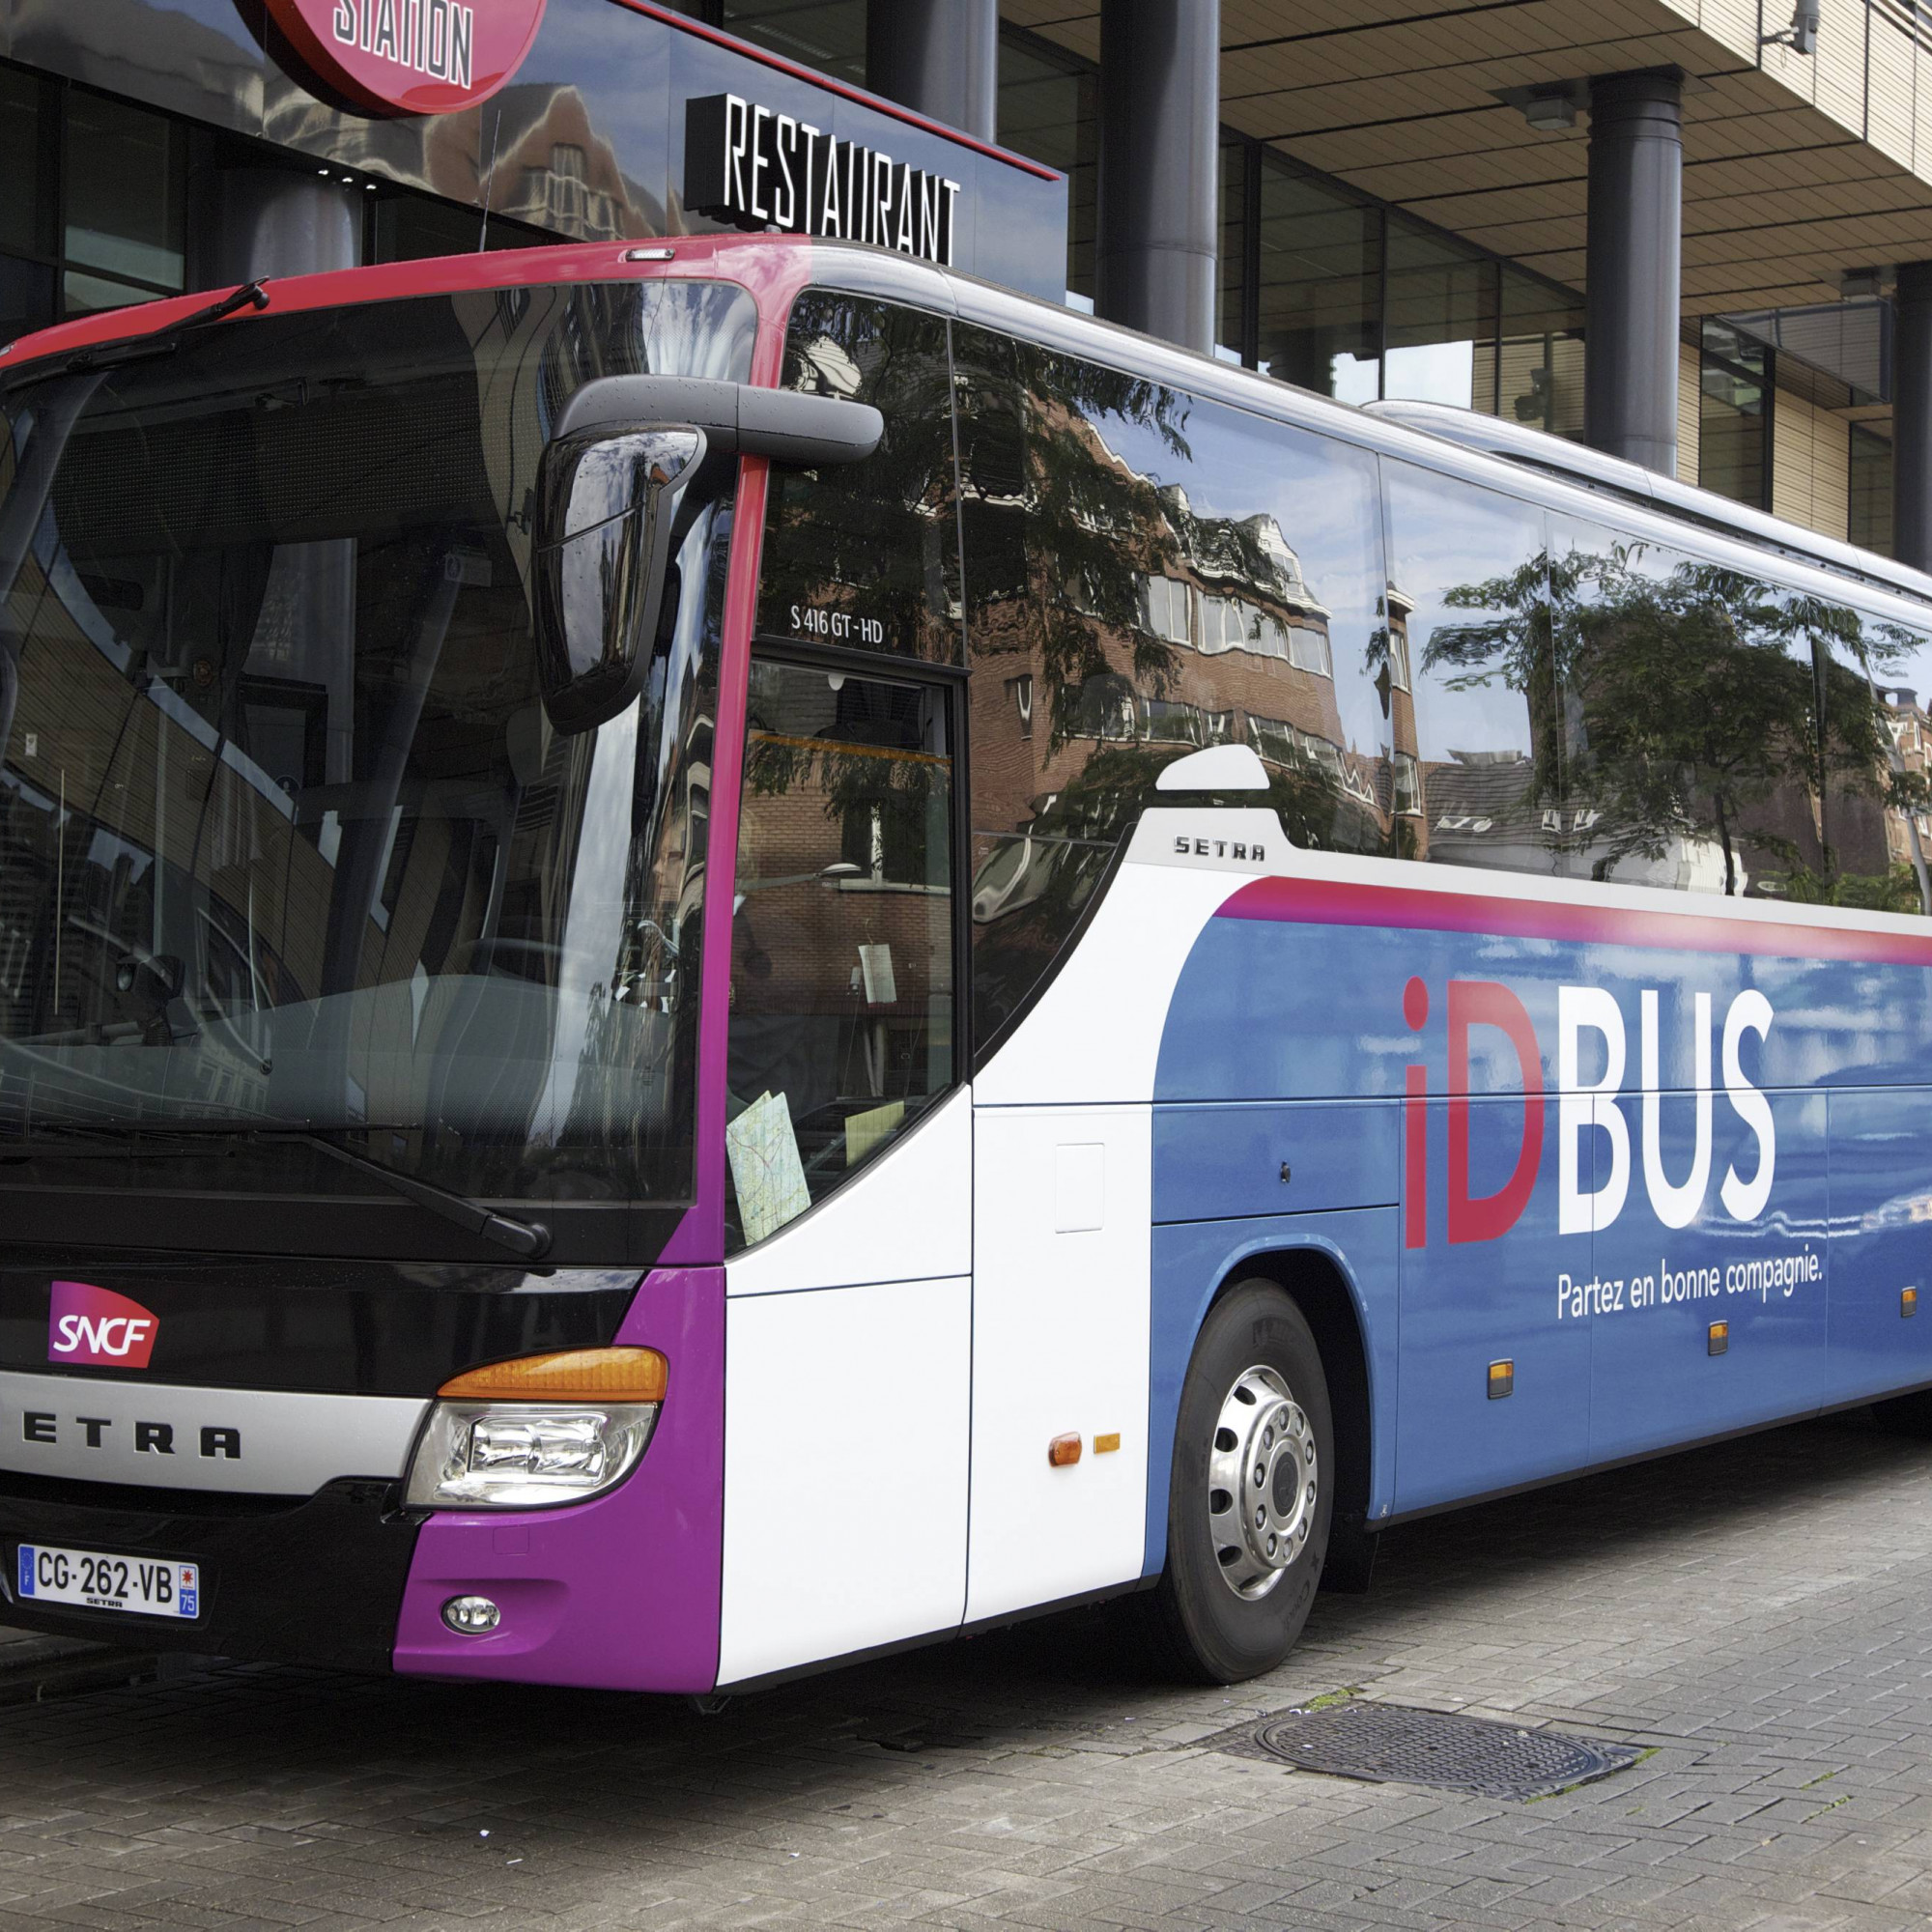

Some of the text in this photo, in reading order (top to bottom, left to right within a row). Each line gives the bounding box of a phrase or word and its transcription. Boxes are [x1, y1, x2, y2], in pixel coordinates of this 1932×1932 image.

[333, 0, 473, 90] STATION
[724, 93, 961, 268] RESTAURANT
[790, 605, 801, 630] S
[804, 608, 829, 635] 416
[1174, 835, 1265, 862] SETRA
[1557, 1243, 1823, 1320] Partez en bonne compagnie.
[52, 1315, 152, 1356] SNCF
[38, 1551, 173, 1604] CG-262-VB
[86, 1597, 124, 1608] SETRA
[181, 1594, 195, 1612] 75
